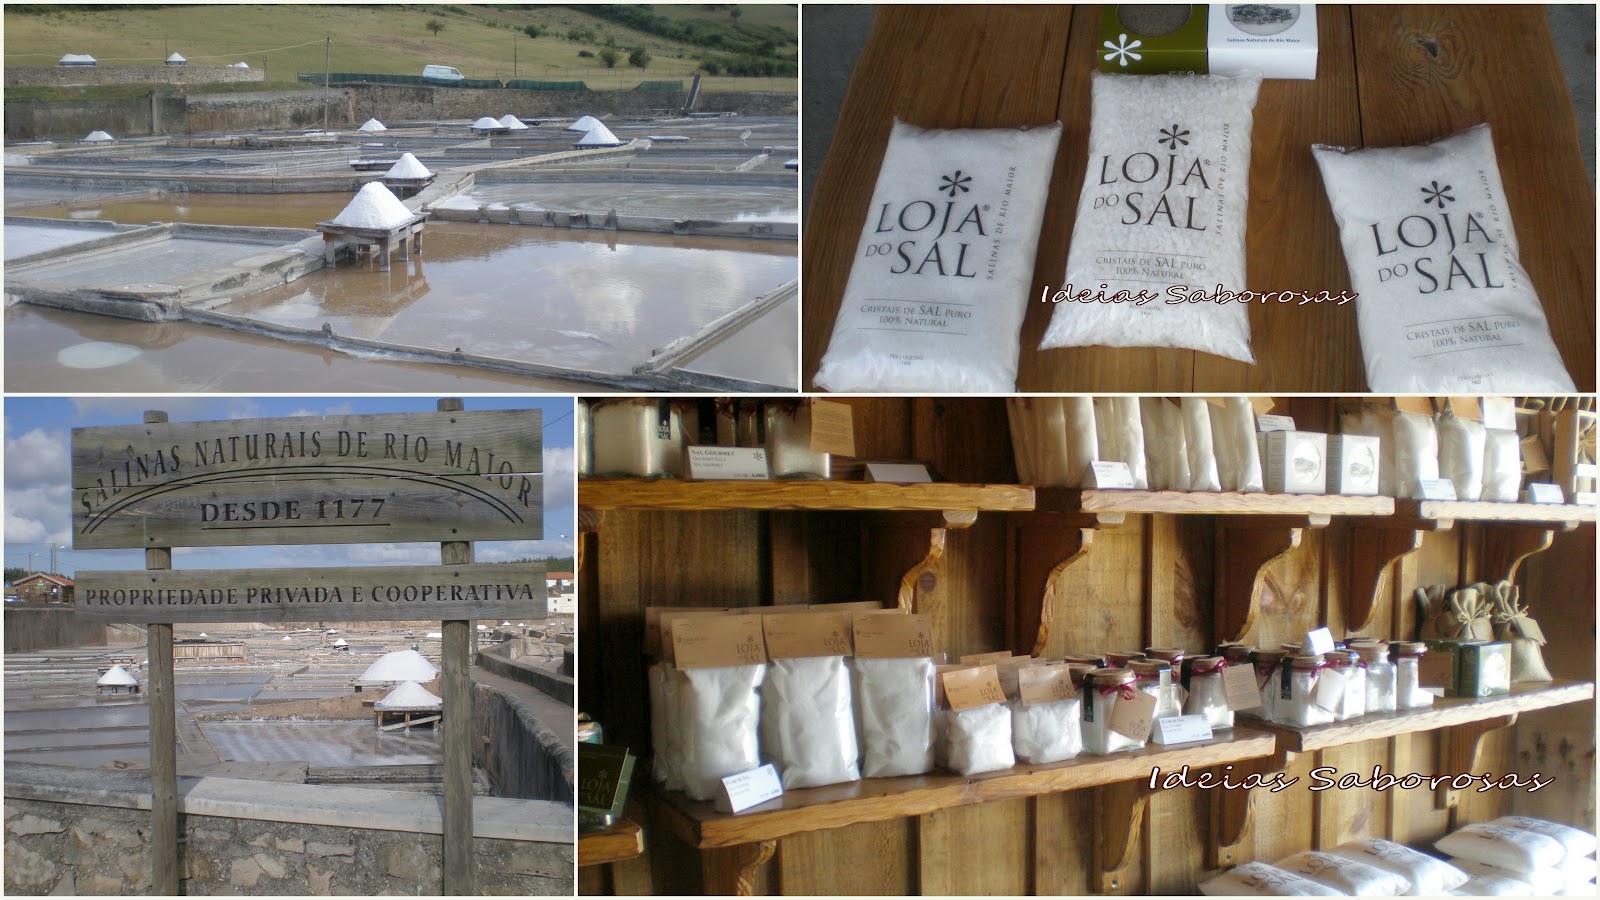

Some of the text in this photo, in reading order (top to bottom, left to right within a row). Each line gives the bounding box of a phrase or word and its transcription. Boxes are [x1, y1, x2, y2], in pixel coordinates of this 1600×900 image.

[1098, 152, 1212, 193] LOJA
[1215, 123, 1231, 236] SALINAS DE RIO MAIOR
[1478, 169, 1494, 200] MAIOR
[875, 200, 988, 241] LOJA
[986, 165, 1017, 281] SALINAS DE RIO MAIOR
[1093, 191, 1207, 231] DO SAL
[1489, 204, 1500, 222] RIO
[1370, 212, 1495, 256] LOJA
[865, 240, 977, 278] DO SAL
[1095, 256, 1207, 271] CRISTAIS DE SAL PURO
[1115, 266, 1185, 280] 100% NATURAL
[1377, 252, 1505, 294] DO SAL
[860, 304, 972, 319] CRISTAIS DE SAL PURO
[879, 315, 948, 328] 100% NATURAL
[1406, 320, 1520, 341] CRISTAIS DE SAL PURO
[1431, 333, 1503, 347] 100% NATURAL
[81, 430, 532, 518] SALINAS NATURAIS DE RIO MAIOR
[200, 498, 386, 522] DESDE 1177
[86, 584, 534, 606] PROPRIEDADE PRIVADA E COOPERATIVA
